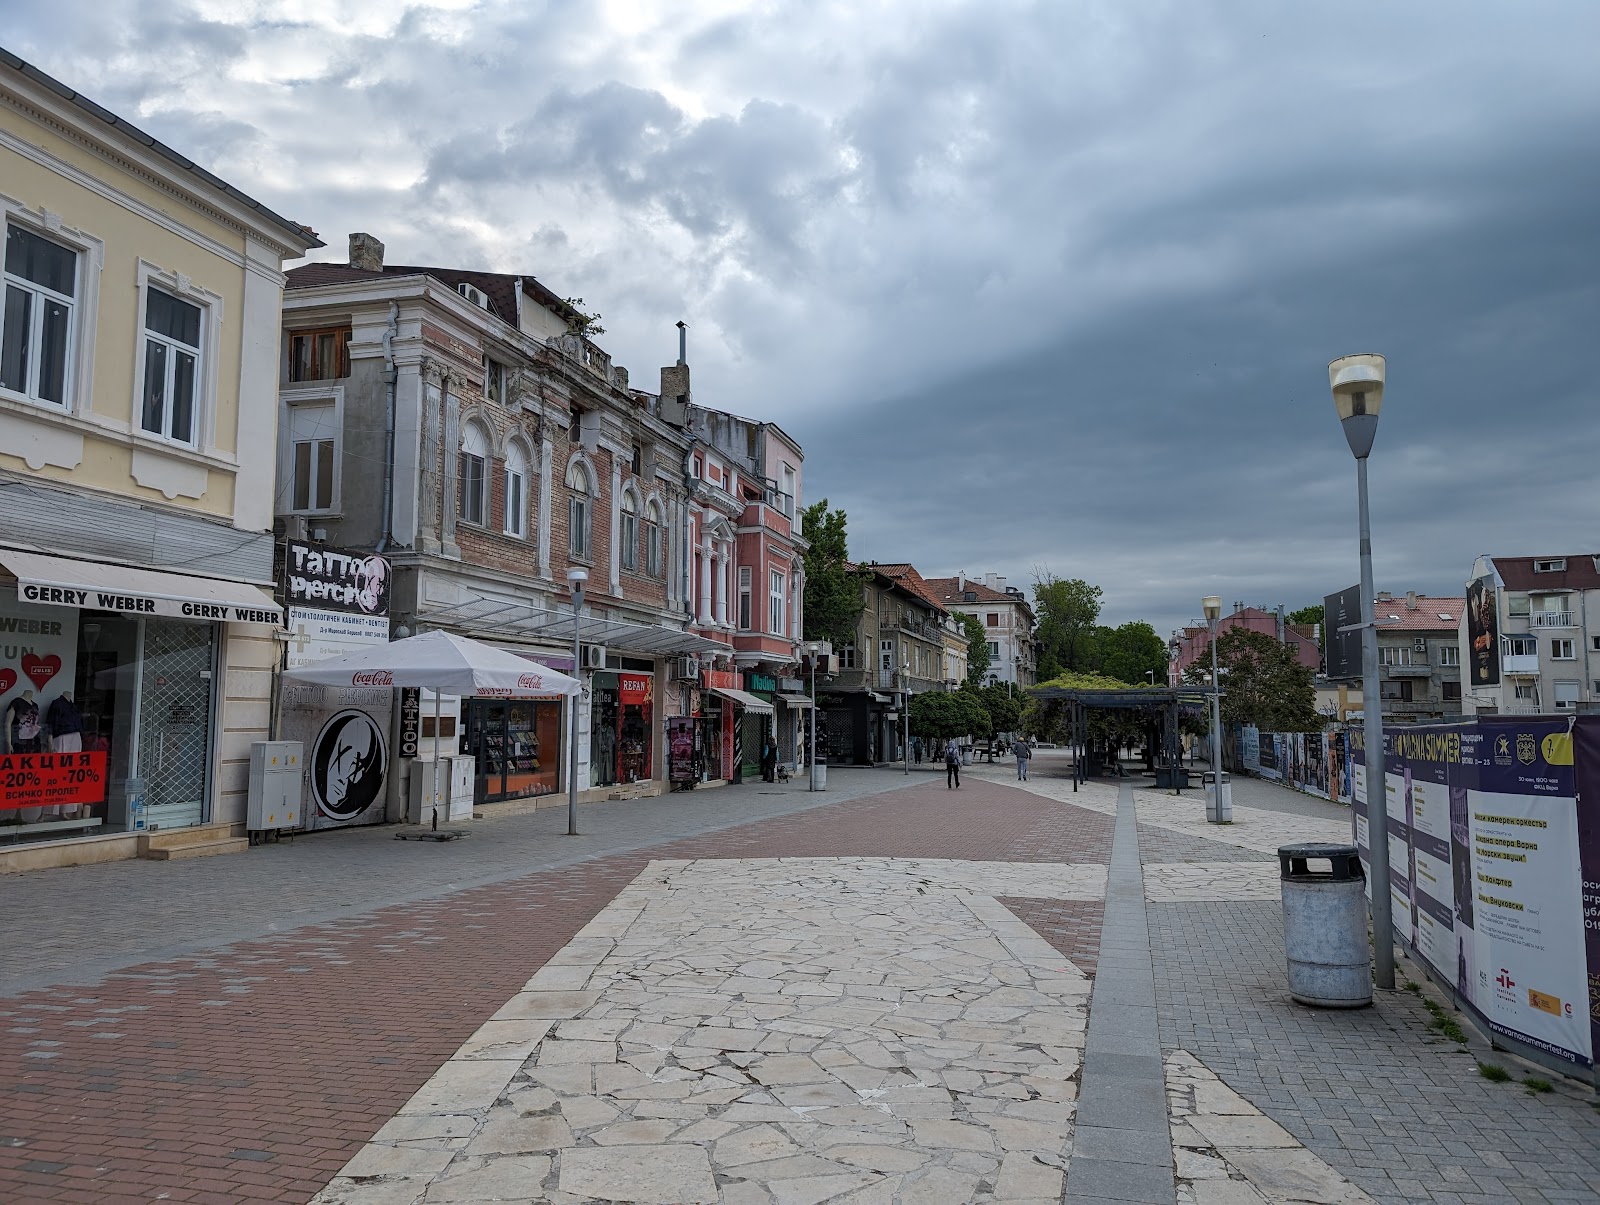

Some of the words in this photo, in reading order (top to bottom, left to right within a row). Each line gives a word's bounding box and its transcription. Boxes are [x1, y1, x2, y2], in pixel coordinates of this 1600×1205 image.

[24, 585, 88, 605] GERRY
[97, 593, 155, 612] WEBER
[181, 602, 229, 618] GERRY
[235, 608, 279, 623] WEBER
[0, 617, 62, 635] WEBER
[352, 670, 394, 686] Coca-Cola
[623, 680, 645, 691] REFAN
[402, 687, 419, 753] TATTOO
[0, 754, 91, 770] АКЦИЯ
[0, 771, 41, 787] -20%
[47, 778, 58, 786] до
[63, 768, 100, 783] -70%
[6, 789, 42, 800] ВСИЧКО
[45, 786, 80, 796] ПРОЛЕТ
[1487, 815, 1515, 826] камерен
[1516, 818, 1547, 829] оркестър
[1495, 838, 1515, 849] опера
[1516, 839, 1538, 850] Варна
[1489, 1022, 1575, 1062] www.varnasummerfest.org
